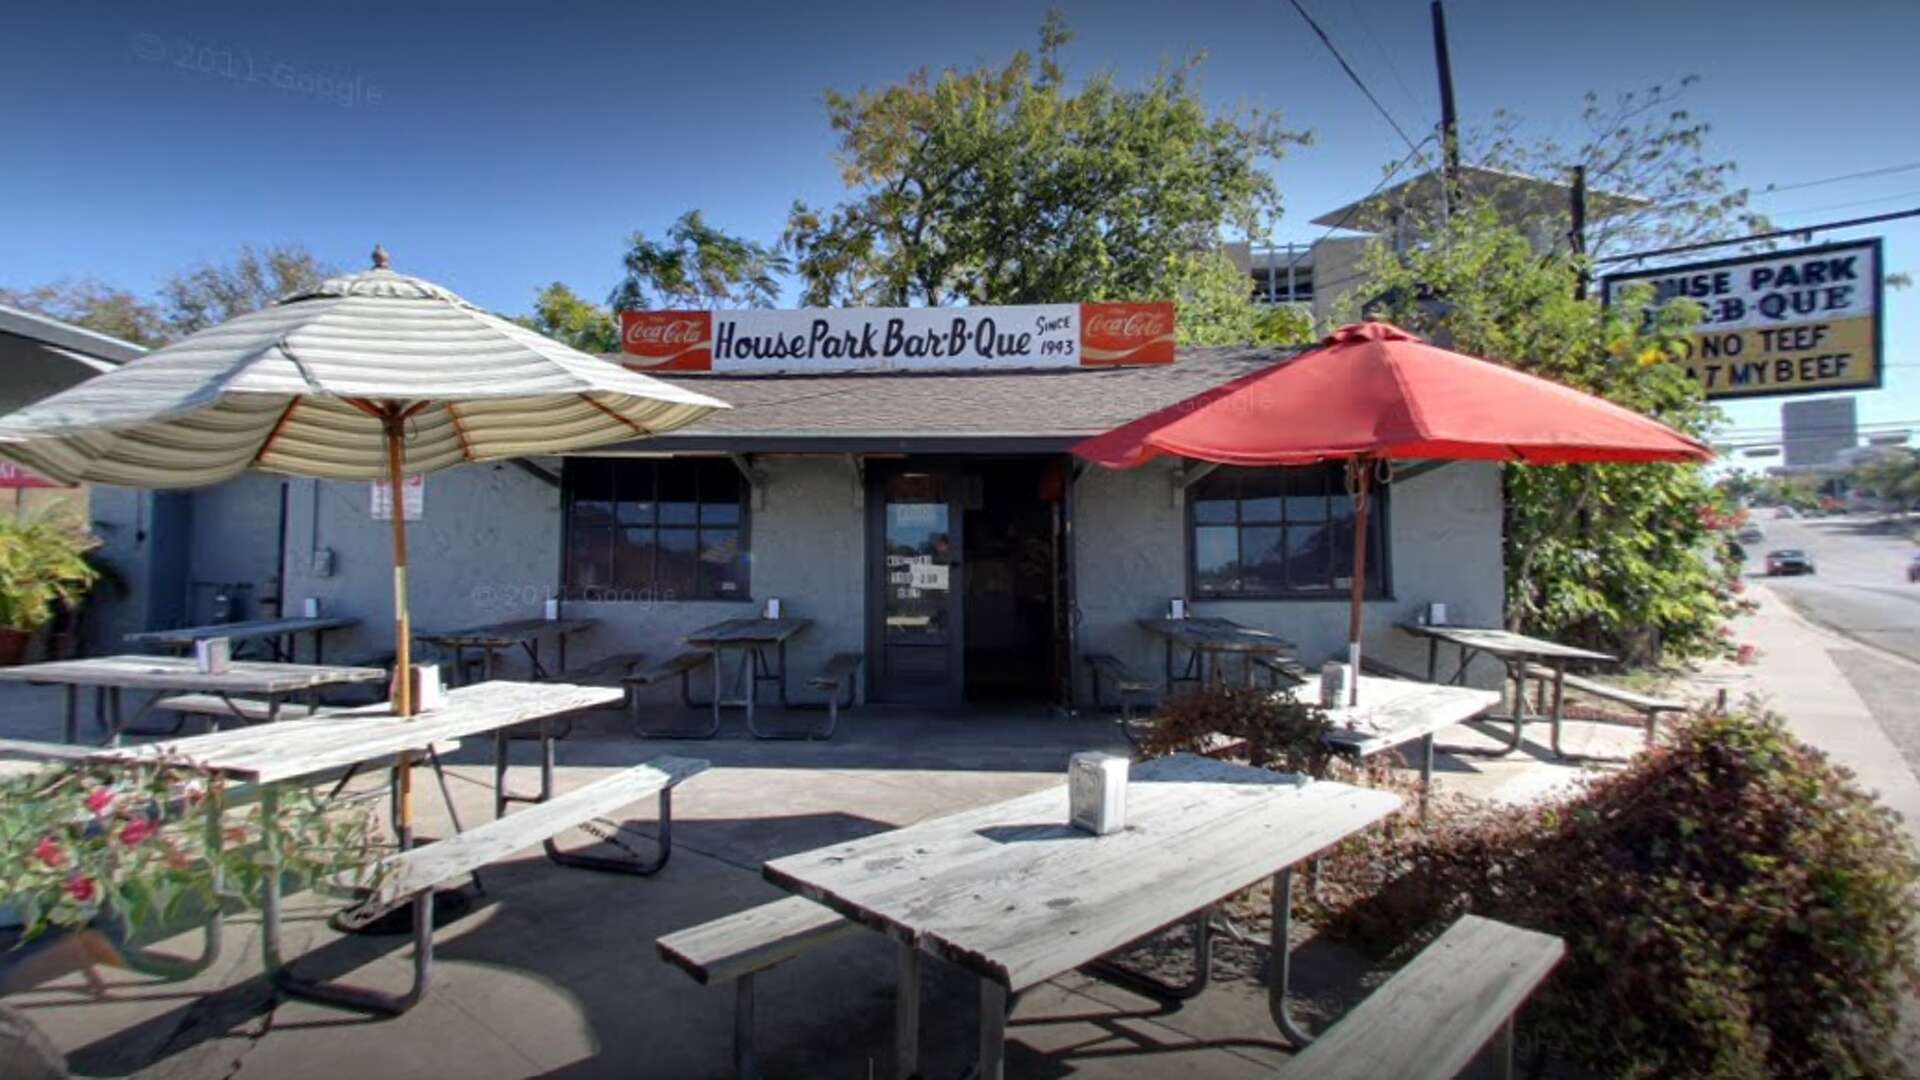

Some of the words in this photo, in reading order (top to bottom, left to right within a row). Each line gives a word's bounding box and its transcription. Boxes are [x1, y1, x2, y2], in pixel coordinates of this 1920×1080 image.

[1751, 256, 1858, 292] PARK
[626, 319, 703, 344] Coca-Cola
[1035, 315, 1072, 335] SINCE
[1087, 311, 1167, 338] Coca-Cola
[1702, 333, 1743, 358] NO
[1757, 323, 1831, 353] TEEF
[1775, 352, 1853, 382] BEEF
